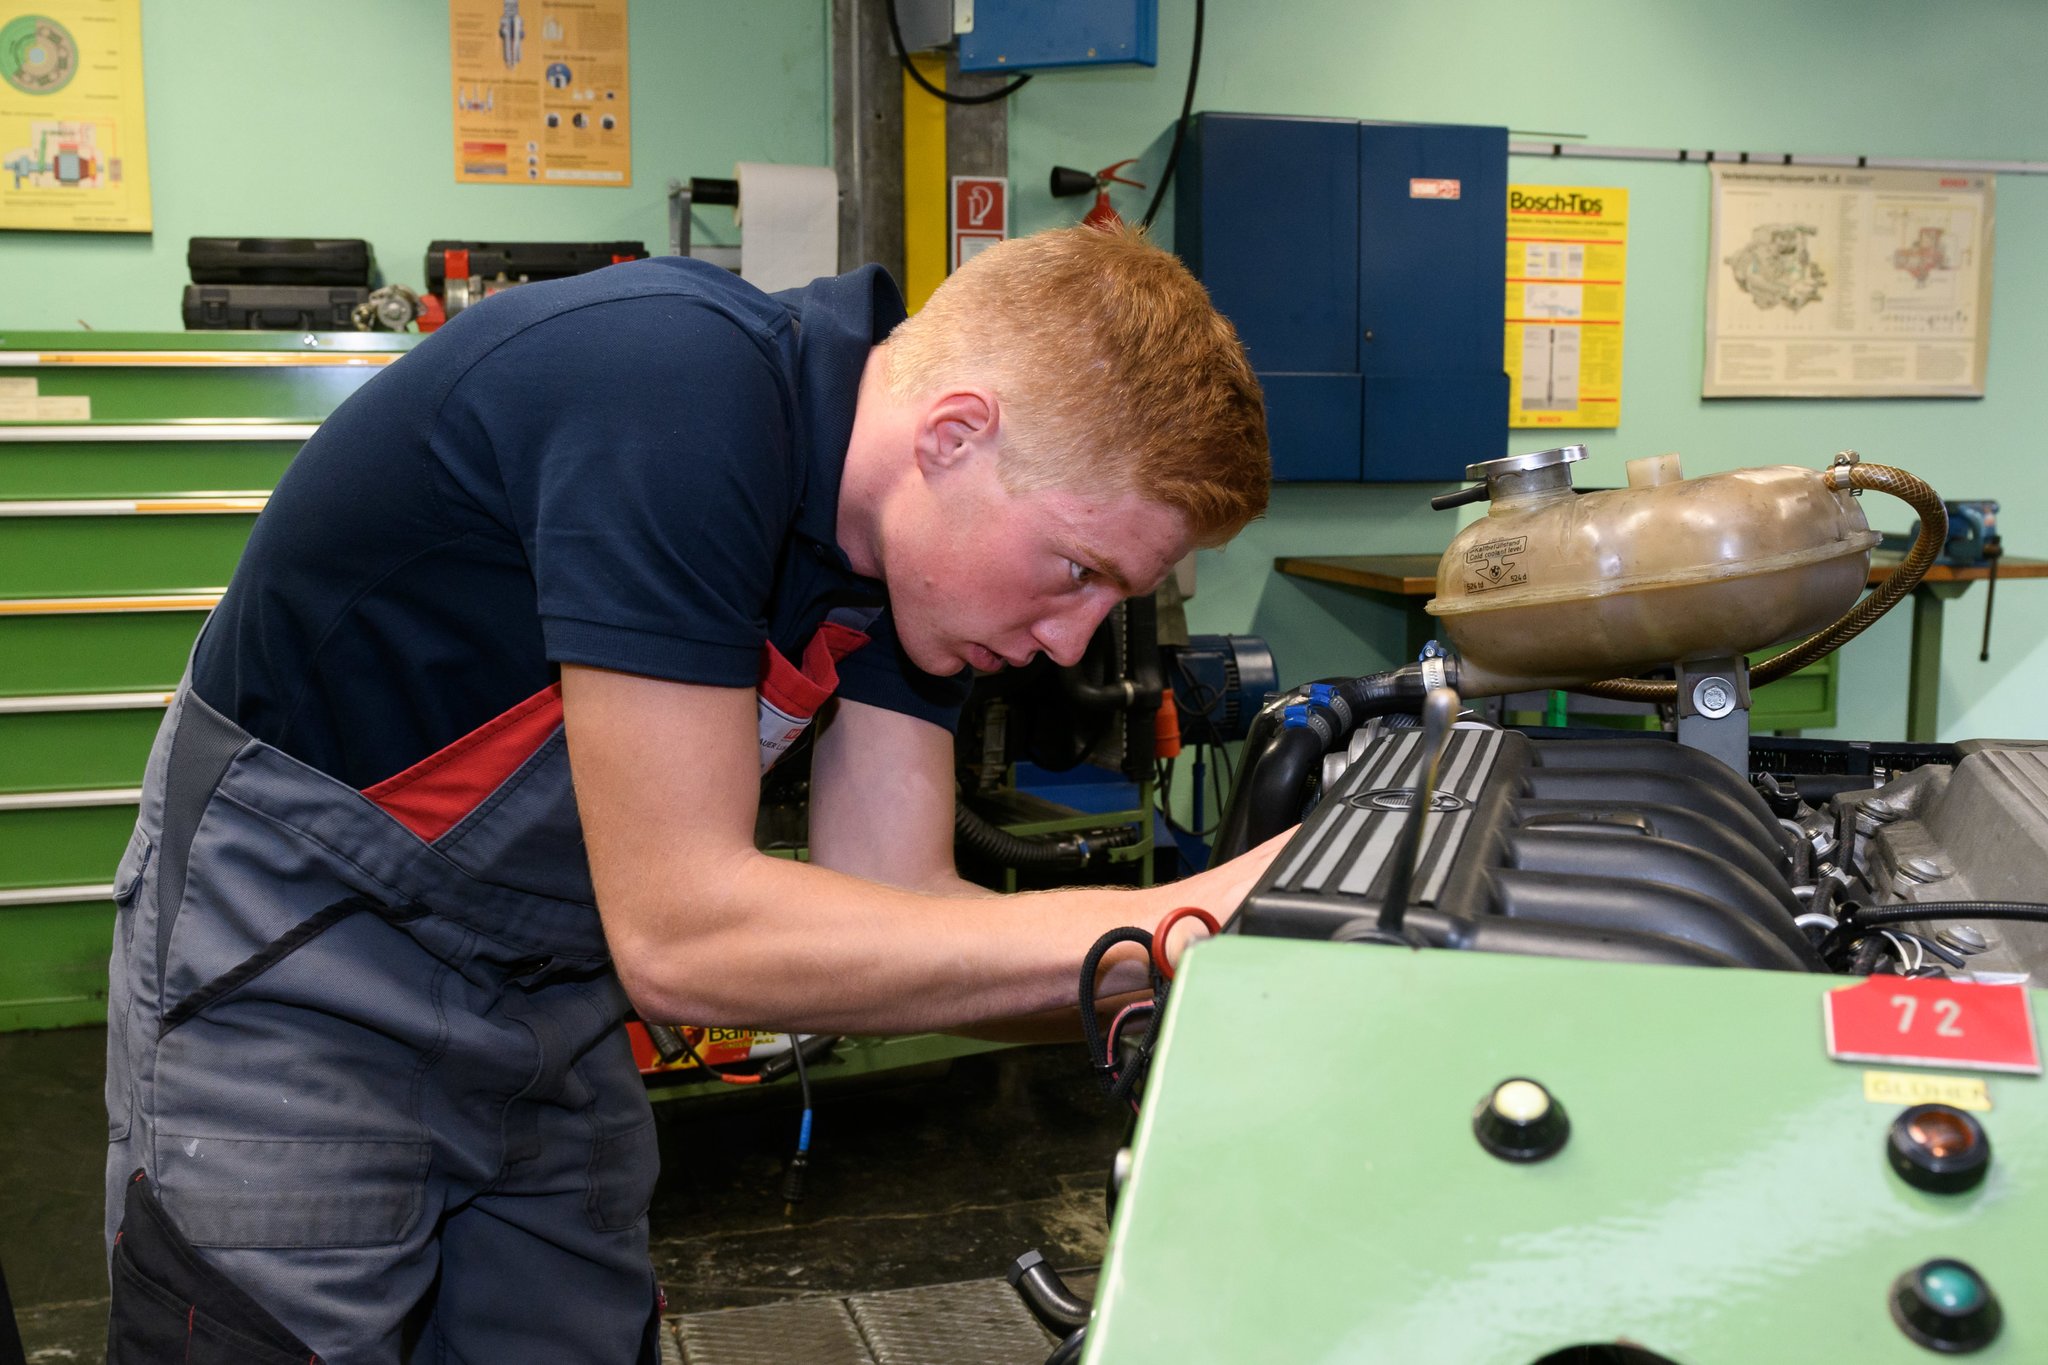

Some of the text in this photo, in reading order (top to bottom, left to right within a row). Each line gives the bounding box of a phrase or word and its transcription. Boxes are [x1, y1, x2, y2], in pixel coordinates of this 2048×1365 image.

[1510, 191, 1603, 215] Bosch-Tips
[1469, 544, 1523, 561] Cold coolant level
[1511, 574, 1522, 582] 524
[1891, 994, 1964, 1037] 72
[709, 1027, 779, 1042] Bann
